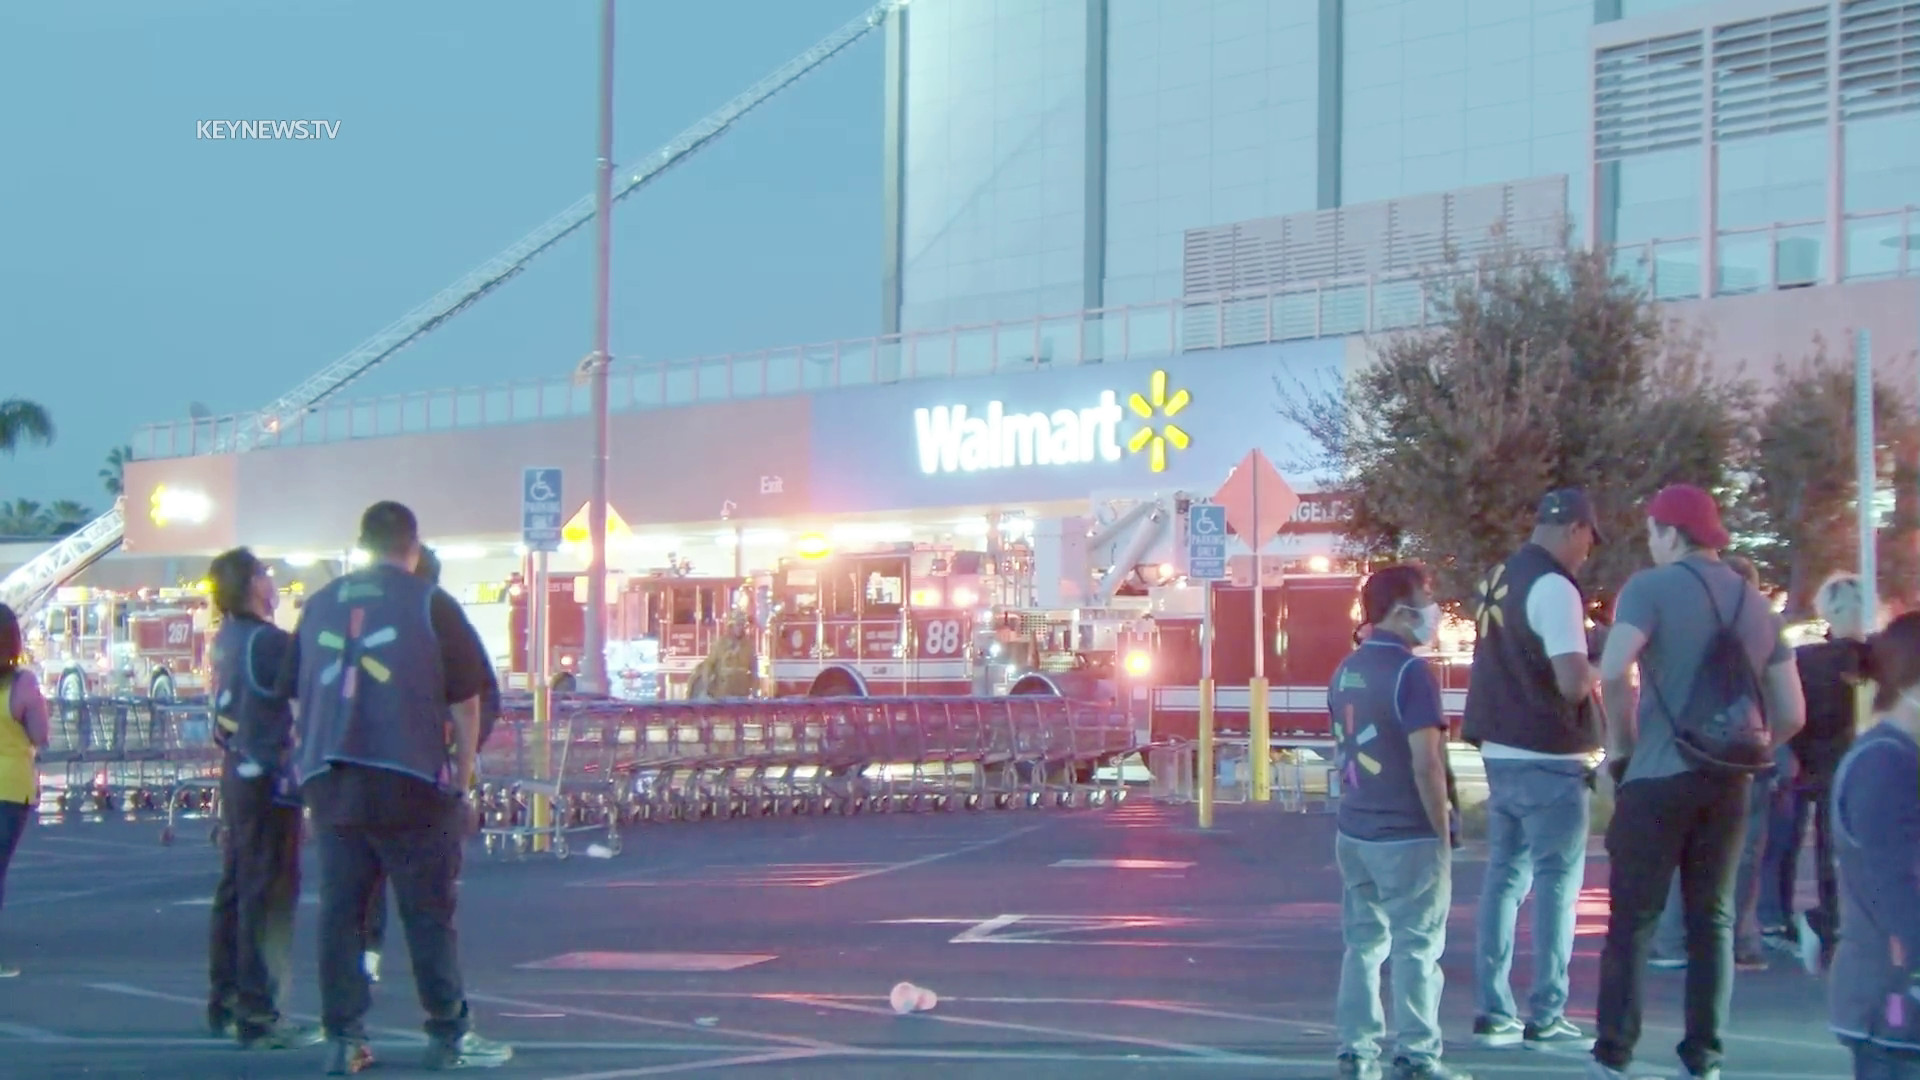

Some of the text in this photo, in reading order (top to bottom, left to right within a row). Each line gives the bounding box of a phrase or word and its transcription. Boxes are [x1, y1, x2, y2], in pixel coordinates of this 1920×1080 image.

[914, 390, 1122, 473] Walmart
[760, 476, 783, 493] Exit
[1192, 535, 1224, 544] PARKING
[1197, 546, 1217, 556] ONLY
[168, 623, 189, 643] 287
[926, 620, 959, 654] 88
